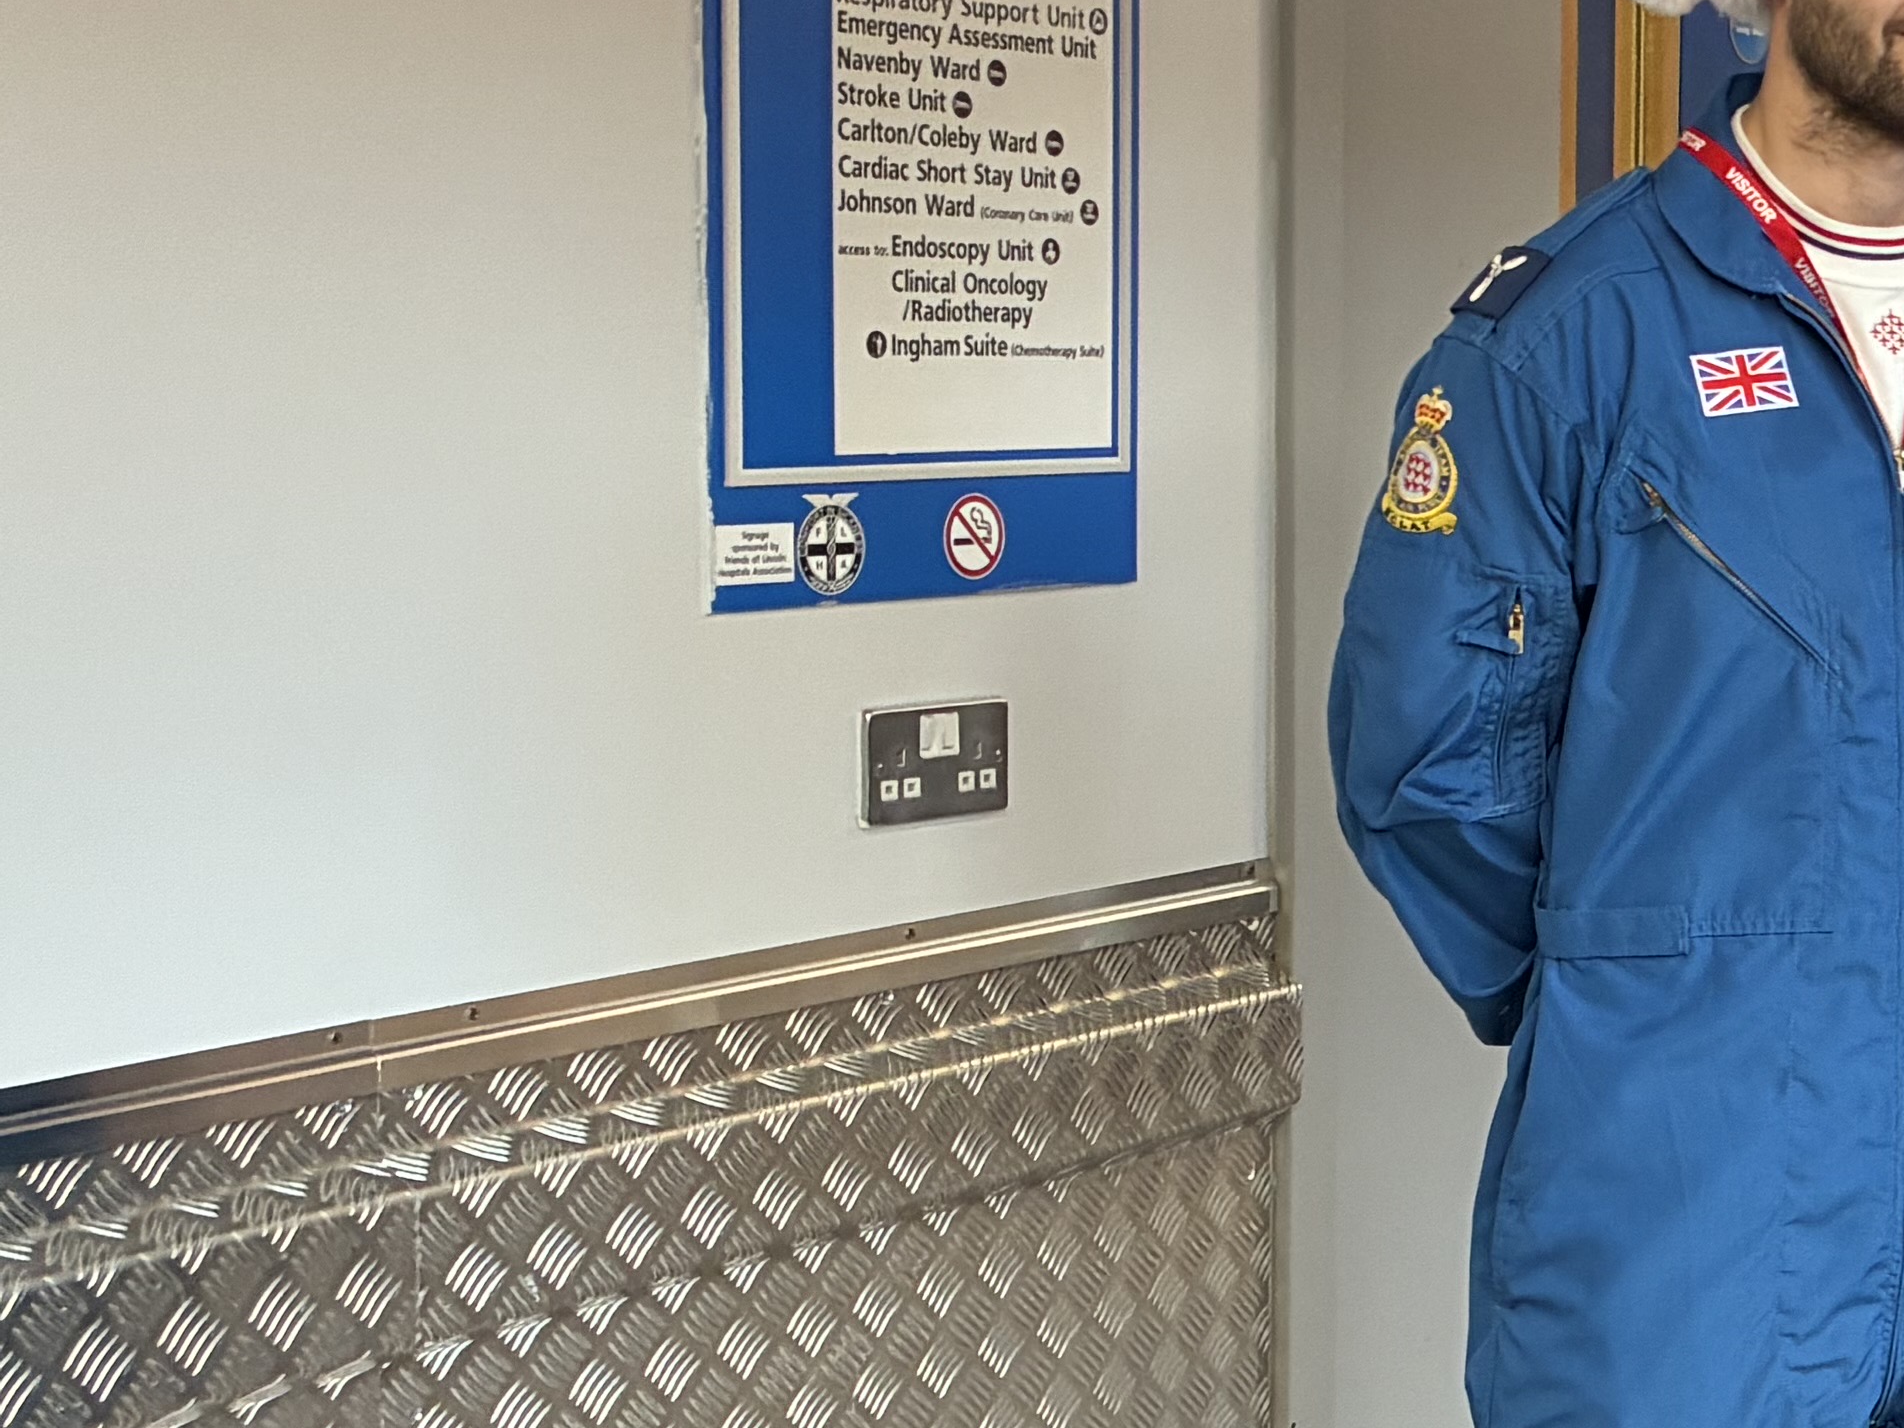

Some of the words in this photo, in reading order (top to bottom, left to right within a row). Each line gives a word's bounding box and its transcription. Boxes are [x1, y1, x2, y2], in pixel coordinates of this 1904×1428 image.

[1048, 5, 1086, 32] Unit
[836, 11, 942, 47] Emergency
[949, 28, 1054, 55] Assessment
[1061, 33, 1098, 60] Unit
[836, 47, 922, 81] Navenby
[930, 54, 981, 82] Ward
[837, 82, 901, 109] Stroke
[908, 88, 947, 113] Unit
[837, 117, 981, 155] Carlton/Coleby
[989, 127, 1038, 155] Ward
[838, 154, 910, 182] Cardiac
[916, 159, 967, 185] Short
[973, 162, 1013, 192] Stay
[1020, 165, 1058, 190] Unit
[837, 189, 917, 216] Johnson
[925, 193, 975, 219] Ward
[1725, 167, 1777, 224] VISITOR
[891, 234, 991, 266] Endoscopy
[998, 238, 1034, 262] Unit
[891, 269, 956, 295] Clinical
[963, 272, 1048, 301] Oncology
[902, 299, 1033, 329] /Radiotherapy
[891, 333, 960, 362] Ingham
[964, 331, 1008, 357] Suite
